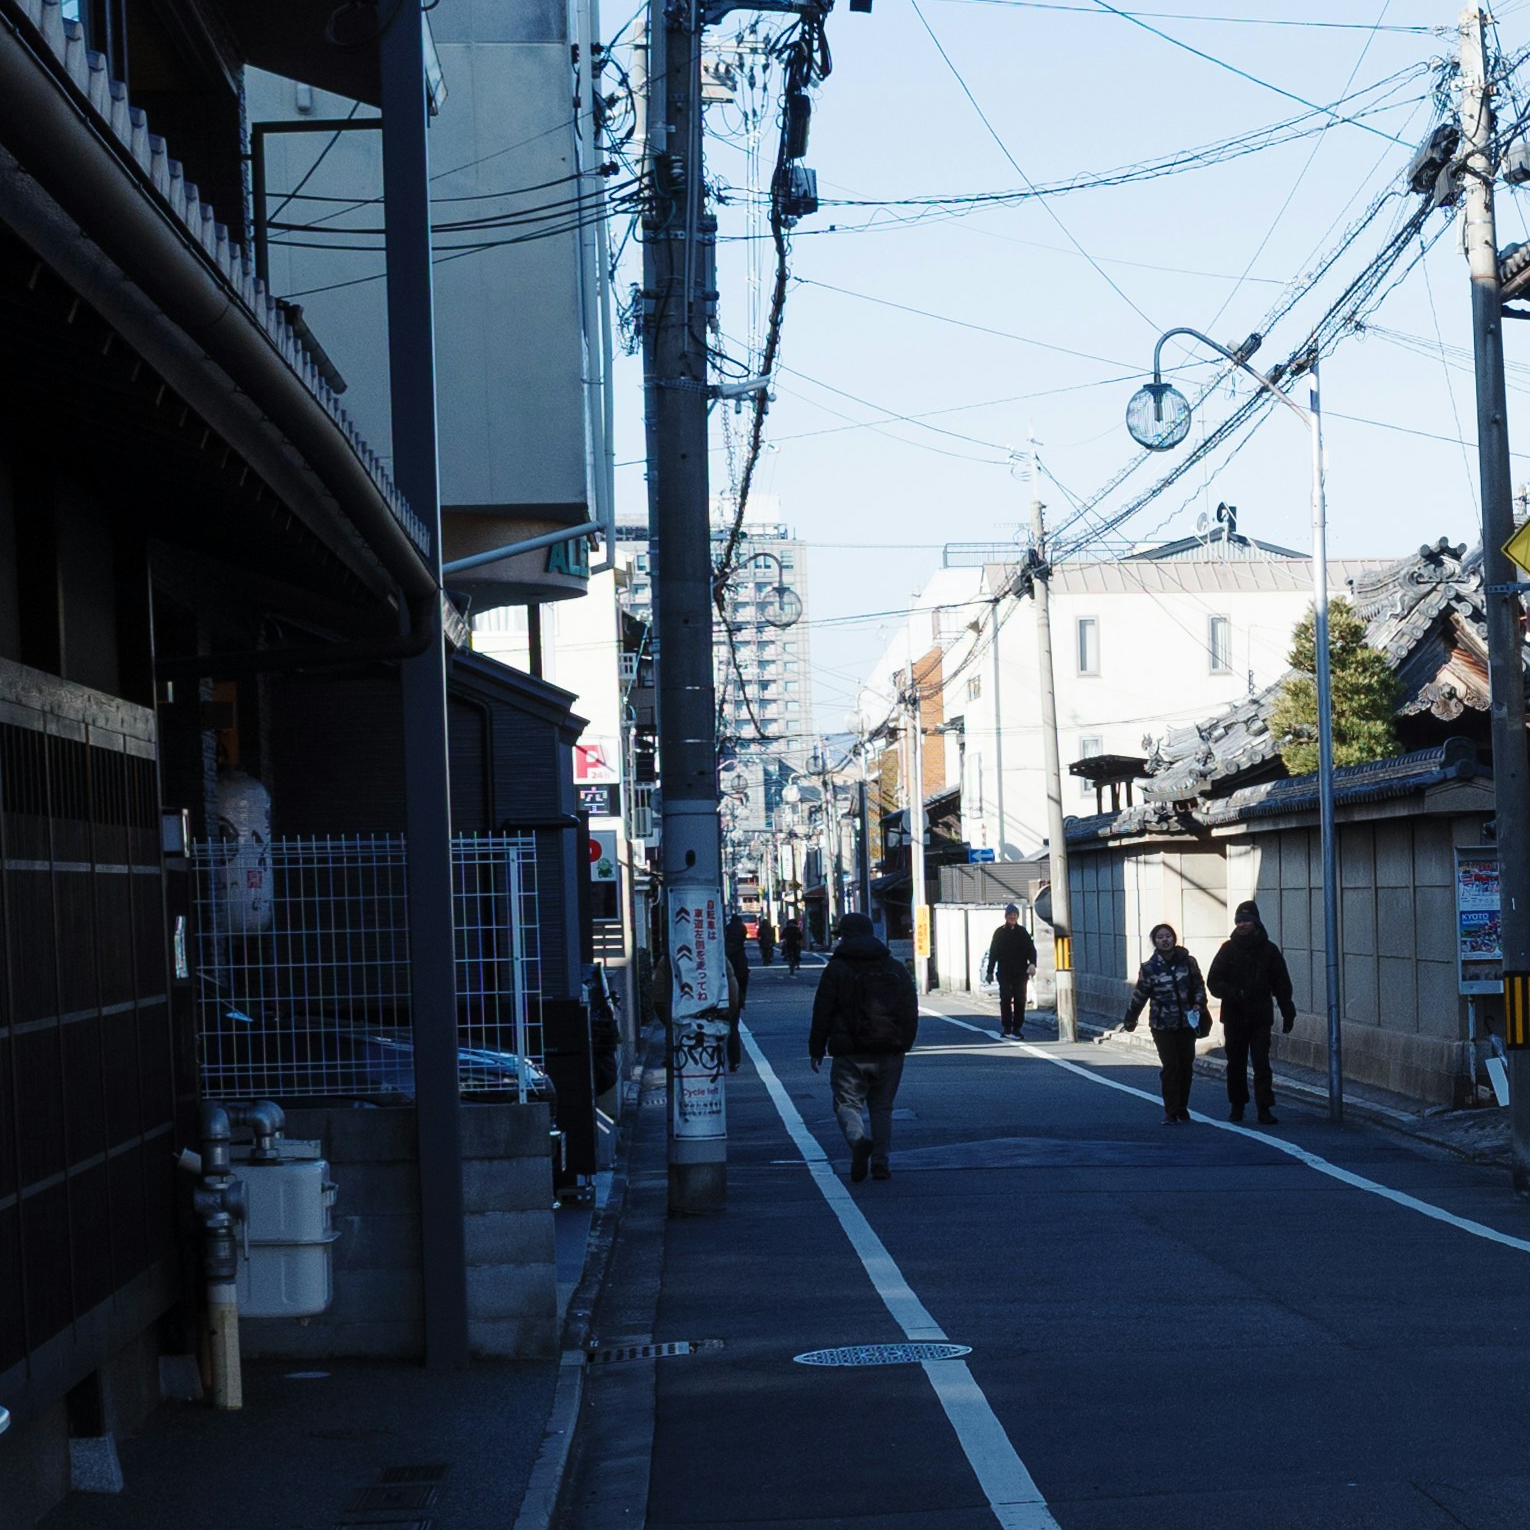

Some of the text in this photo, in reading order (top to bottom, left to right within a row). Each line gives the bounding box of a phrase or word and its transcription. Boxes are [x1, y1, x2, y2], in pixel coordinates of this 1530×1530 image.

[575, 744, 609, 779] P
[580, 786, 609, 814] 空
[706, 899, 718, 941] 自転車は
[1461, 912, 1489, 920] KYOTO
[693, 908, 709, 1002] 車道左側を走ってね
[682, 1086, 720, 1097] Cycle left
